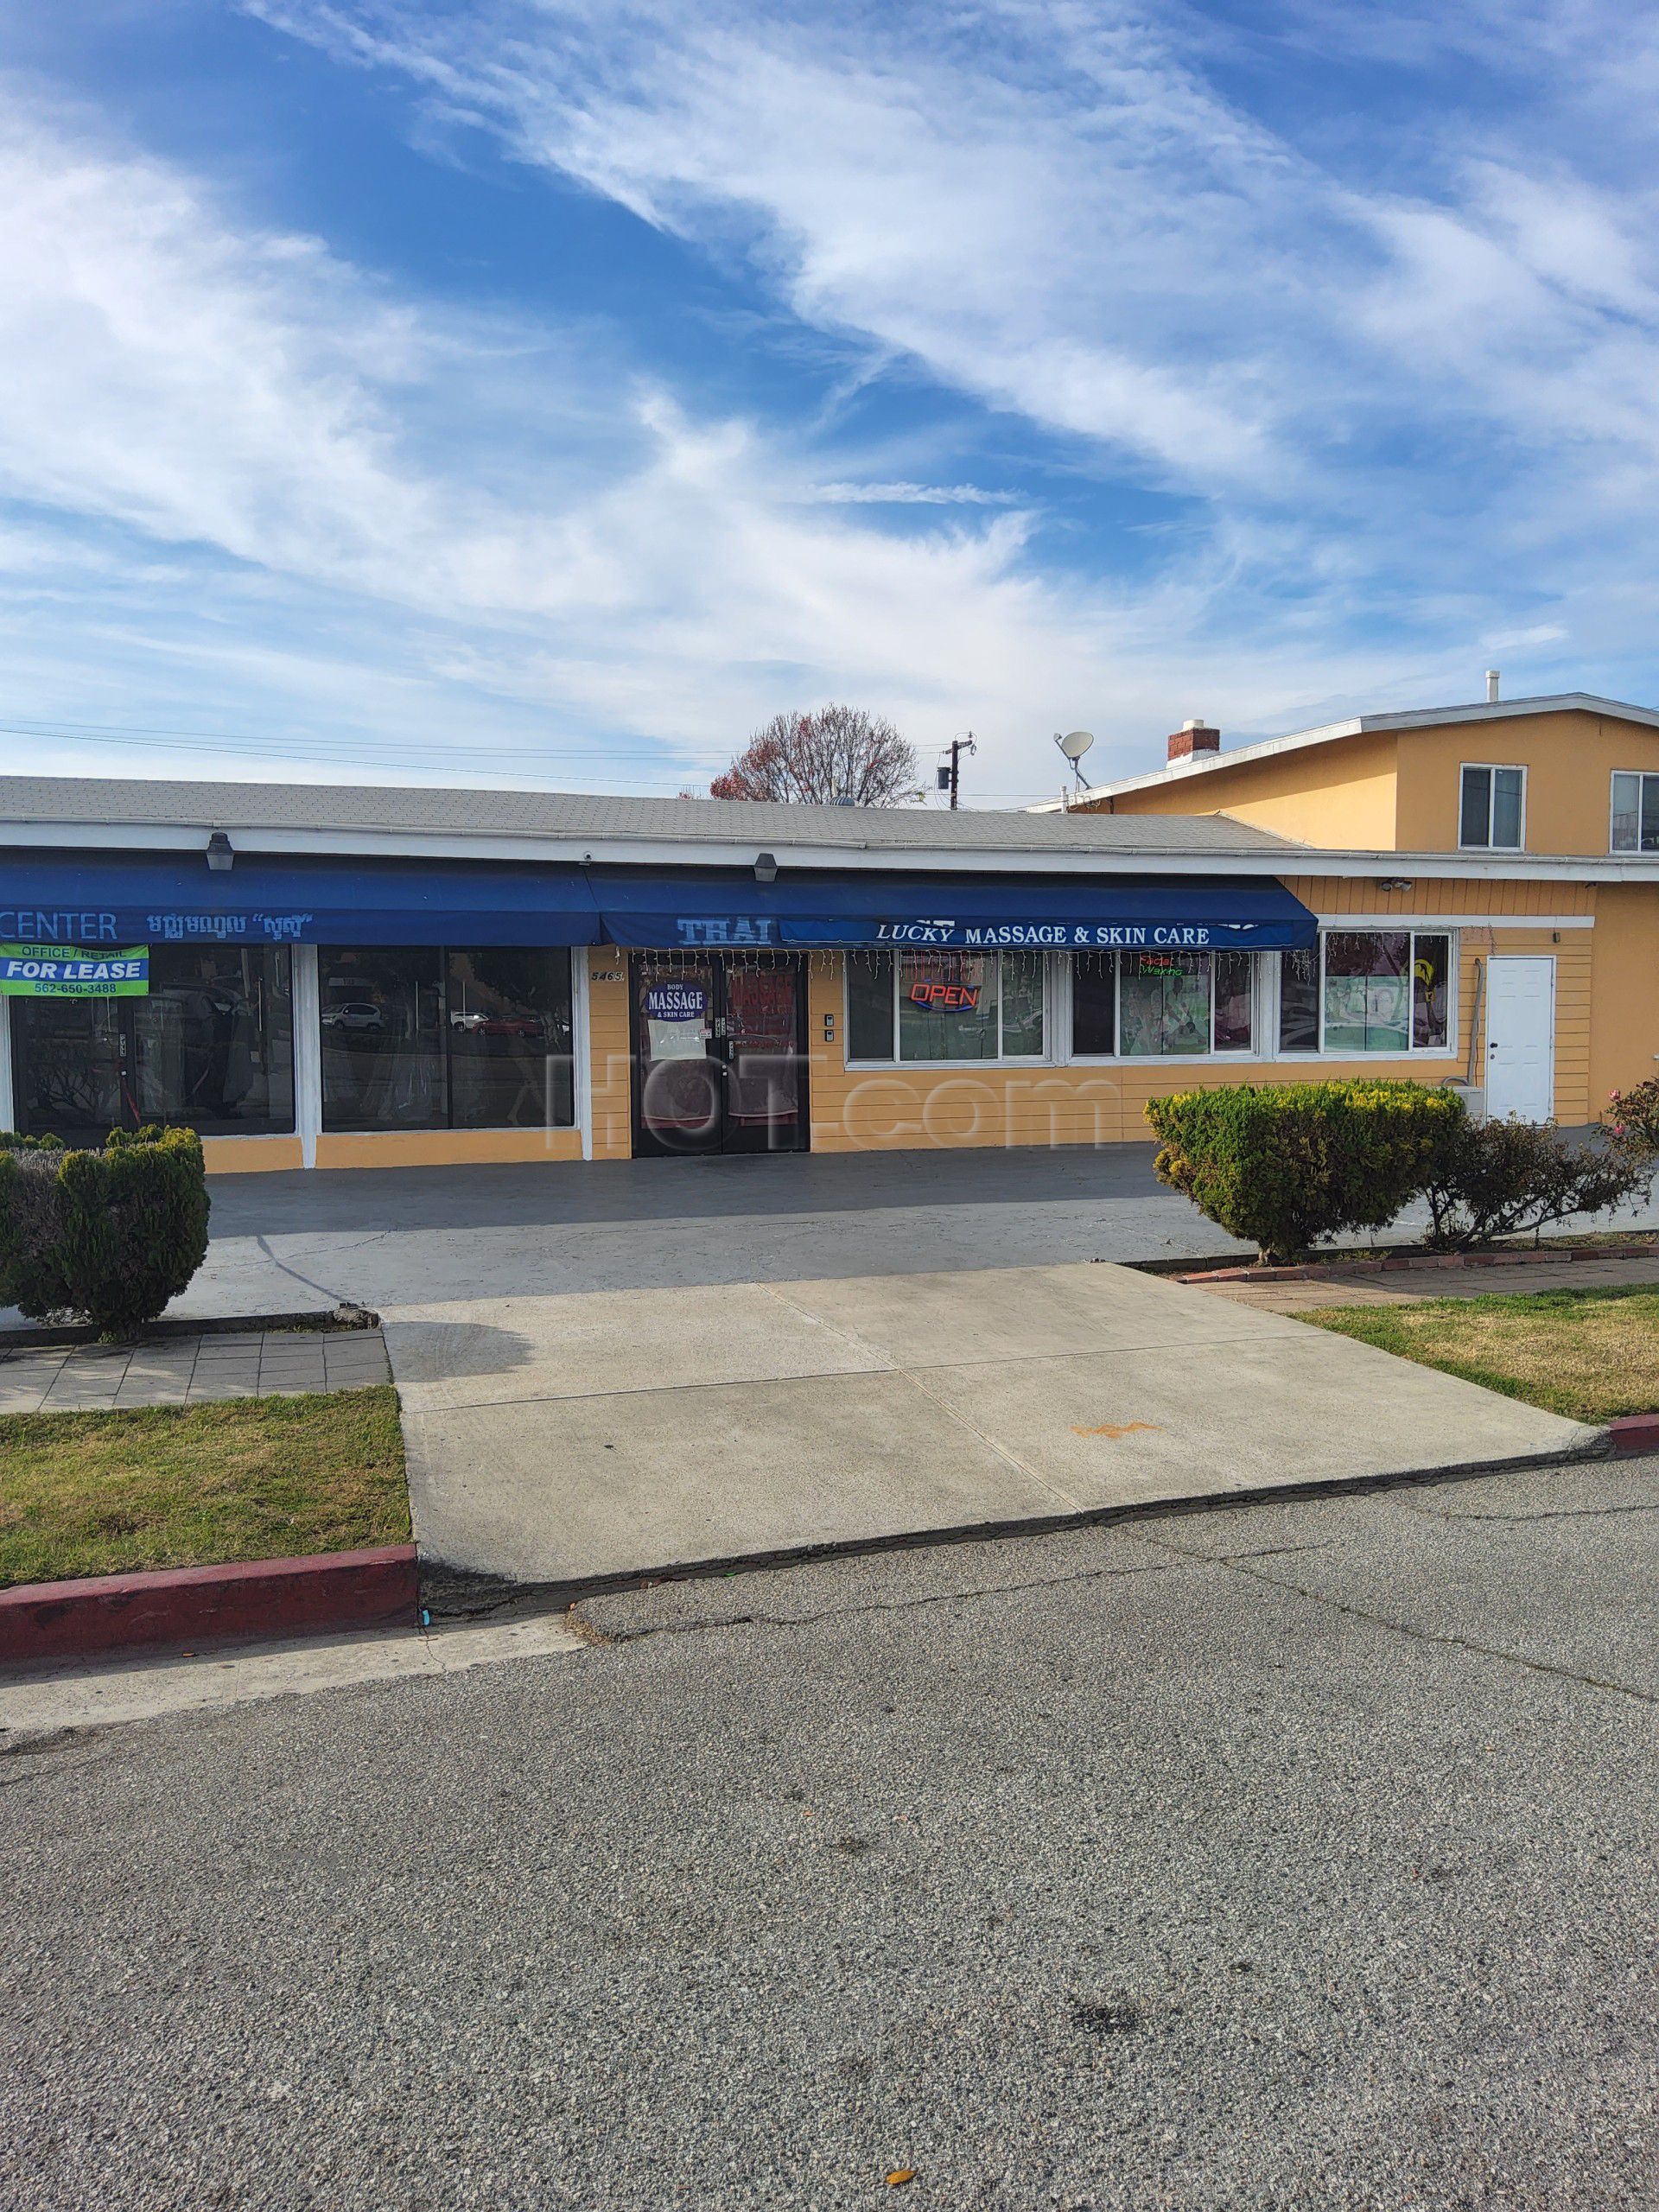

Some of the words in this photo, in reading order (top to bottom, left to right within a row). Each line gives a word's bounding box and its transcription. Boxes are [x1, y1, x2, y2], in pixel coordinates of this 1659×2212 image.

[0, 911, 118, 940] CENTER
[677, 917, 772, 945] THAI
[876, 924, 955, 942] LUCKY
[965, 925, 1067, 944] MASSAGE
[1074, 926, 1090, 944] &
[1096, 927, 1146, 944] SKIN
[1154, 927, 1210, 945] CARE
[22, 946, 71, 958] OFFICE
[81, 950, 127, 959] RETAIL
[6, 961, 58, 979] FOR
[63, 962, 141, 980] LEASE
[591, 971, 622, 981] 5465
[35, 982, 117, 994] 562-650-3488
[911, 983, 979, 1006] OPEN
[649, 991, 703, 1010] MASSAGE
